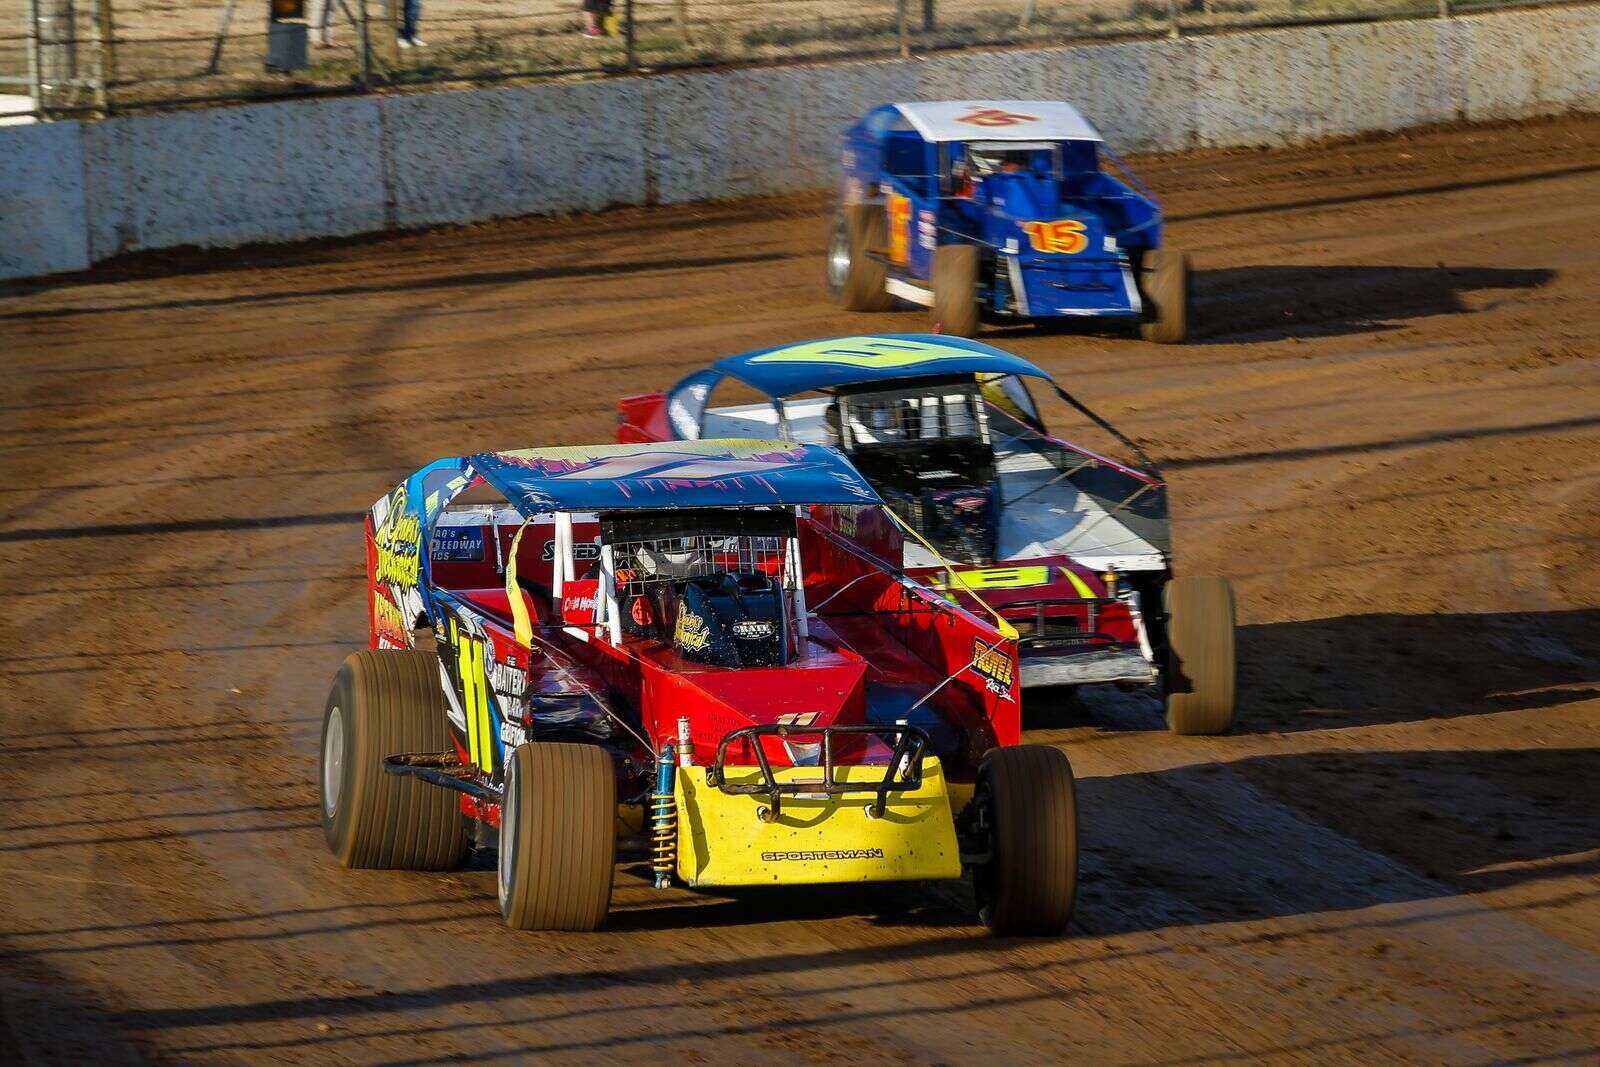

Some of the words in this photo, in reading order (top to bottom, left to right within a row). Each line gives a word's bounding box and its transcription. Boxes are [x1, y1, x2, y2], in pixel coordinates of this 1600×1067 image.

[1015, 219, 1089, 254] 15
[432, 539, 482, 551] PEEDWAY
[542, 540, 601, 561] SEED
[432, 551, 450, 561] ICS
[732, 623, 771, 634] CRATE
[496, 663, 527, 697] BATTERY
[457, 634, 493, 775] 11
[761, 848, 884, 861] SPORTSMAN
